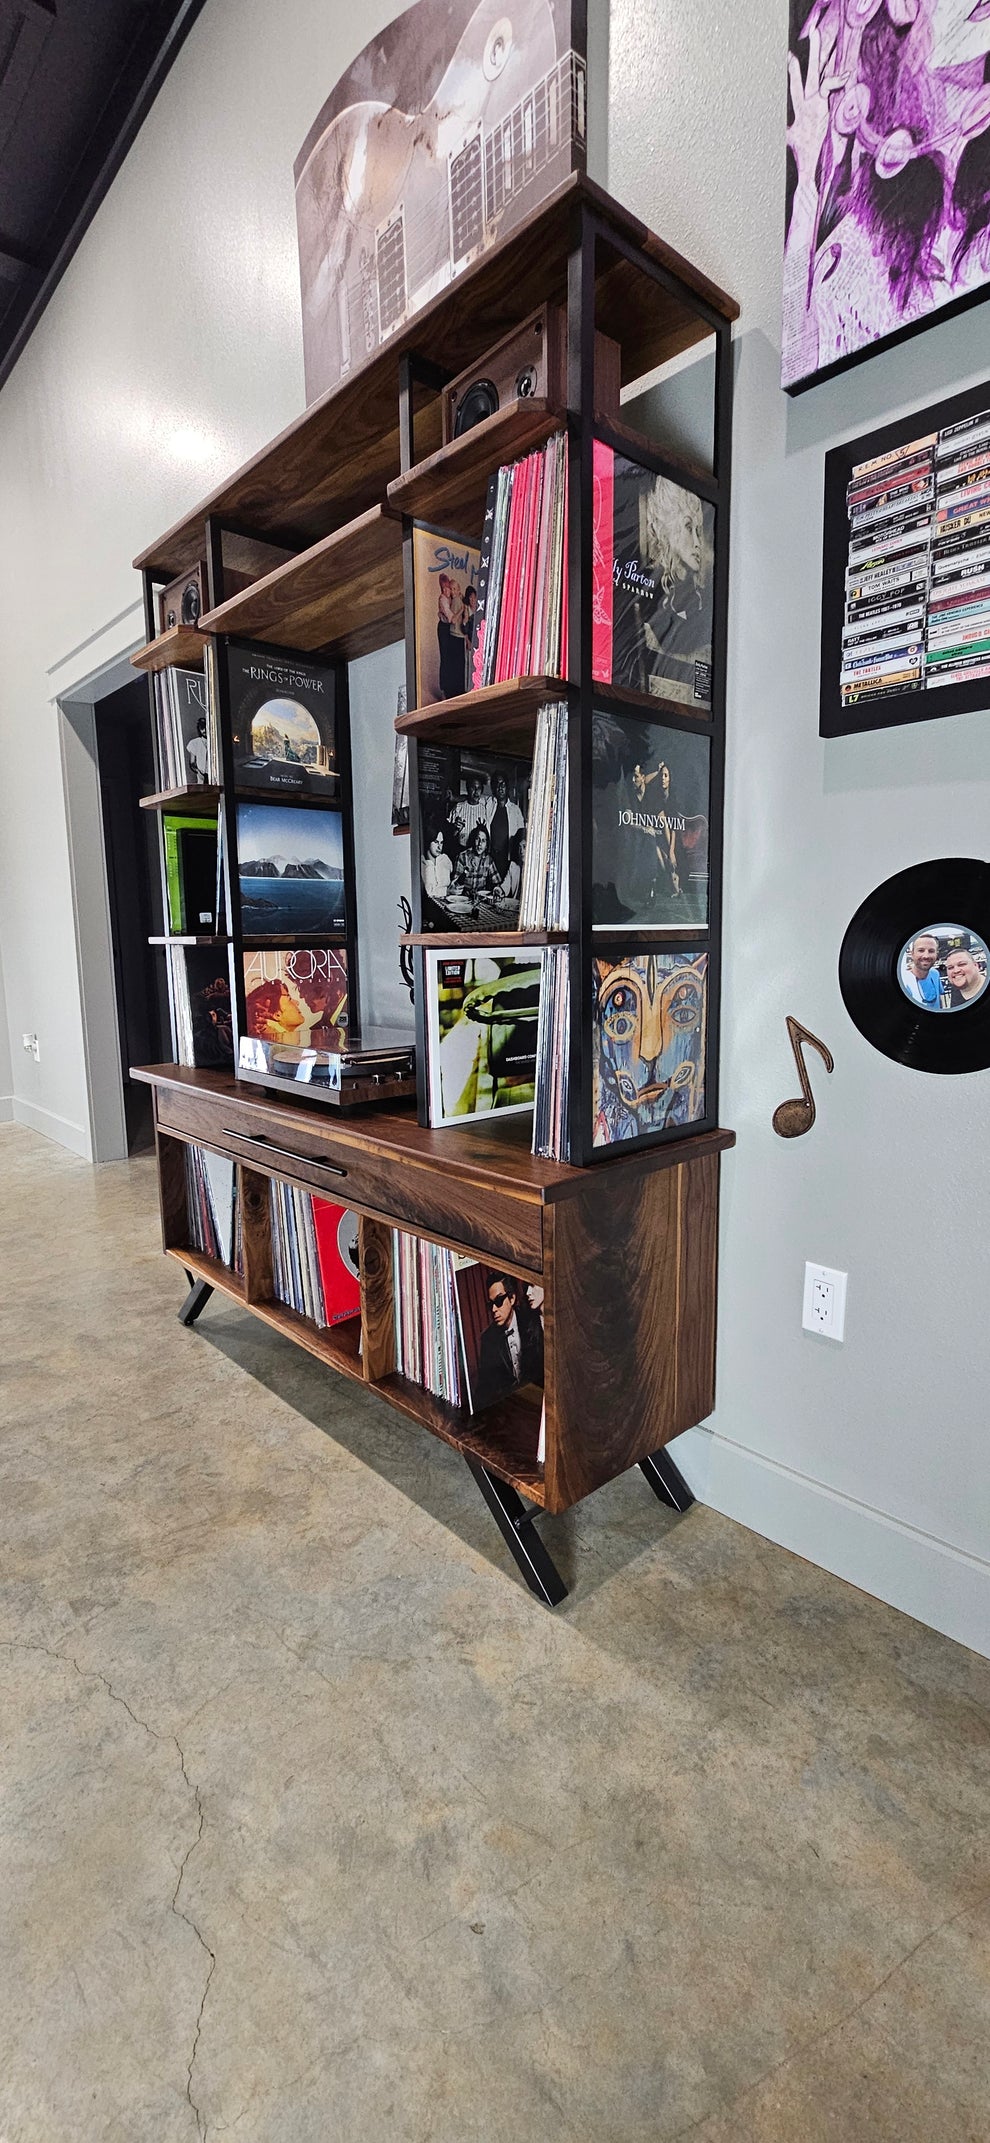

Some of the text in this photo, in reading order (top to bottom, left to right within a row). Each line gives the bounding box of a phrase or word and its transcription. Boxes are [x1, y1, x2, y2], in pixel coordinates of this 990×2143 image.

[624, 560, 655, 588] Parton
[250, 666, 283, 684] RINGS
[289, 675, 325, 693] POWER
[853, 677, 882, 689] METALLICA
[848, 694, 860, 703] L7
[618, 810, 686, 831] JOHNNYSWIM
[244, 950, 347, 980] AURORA
